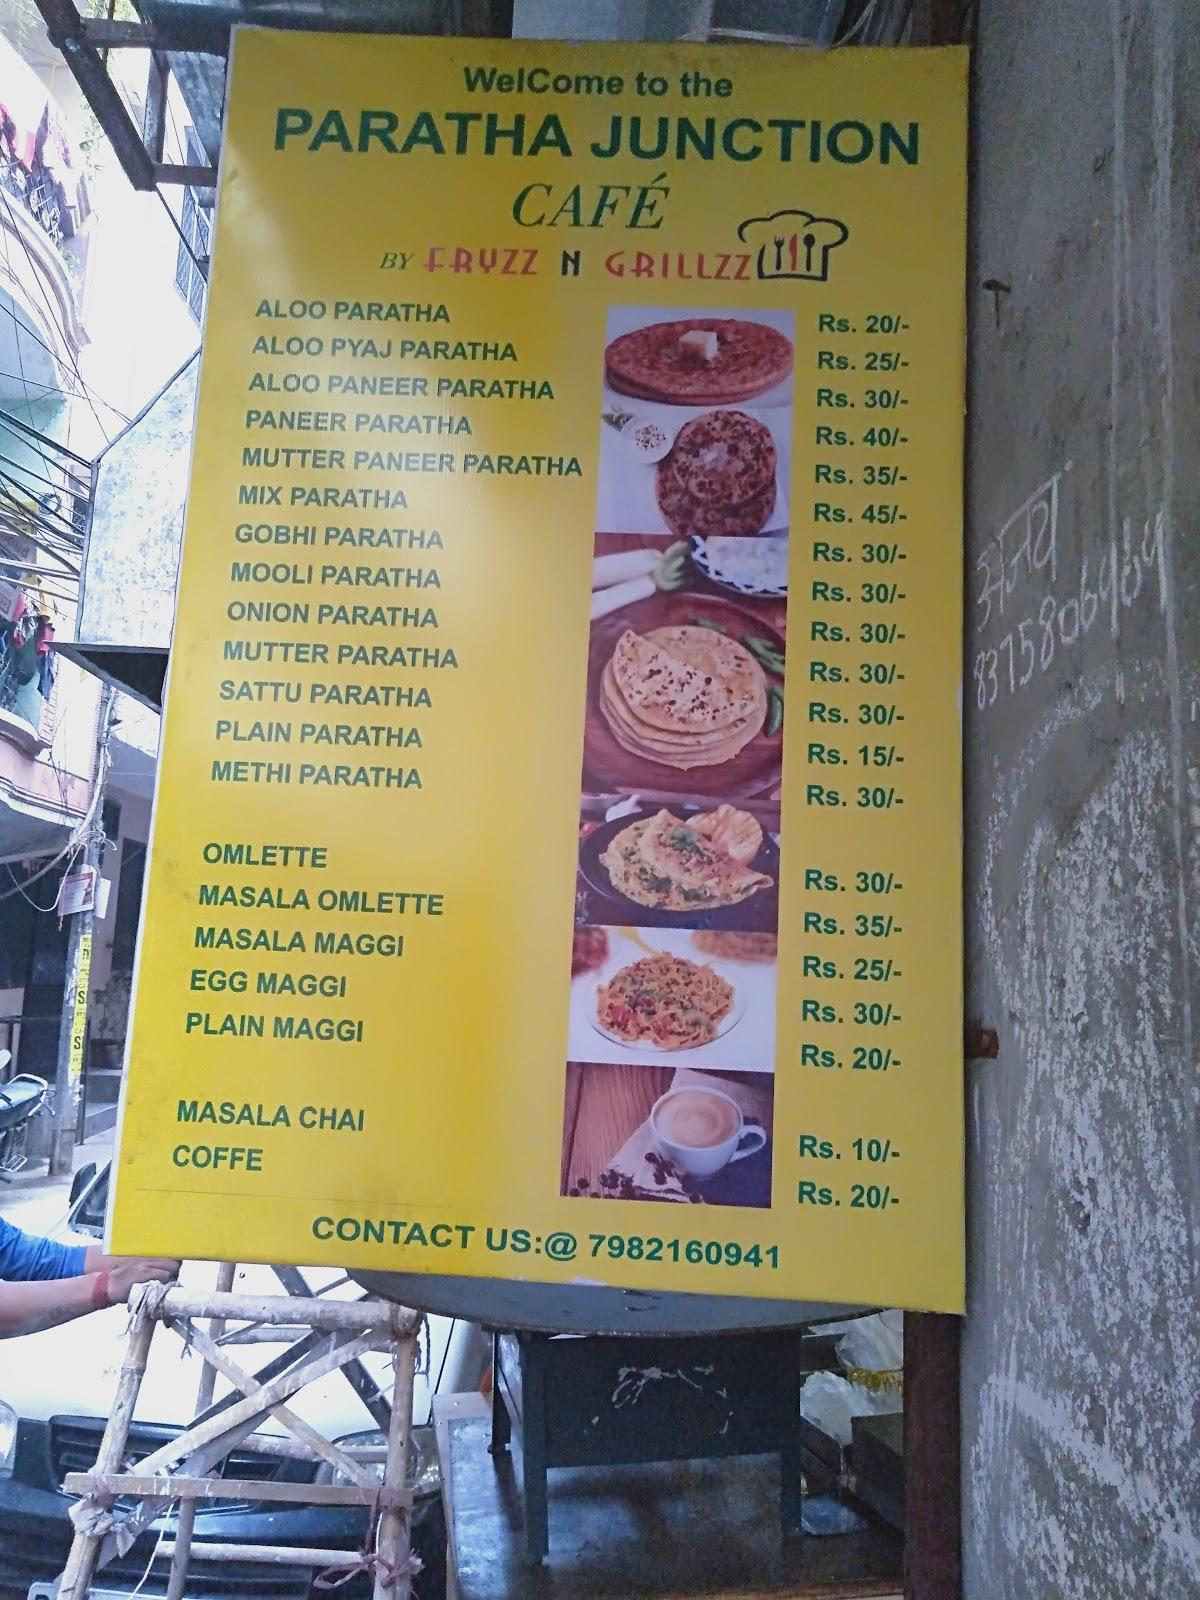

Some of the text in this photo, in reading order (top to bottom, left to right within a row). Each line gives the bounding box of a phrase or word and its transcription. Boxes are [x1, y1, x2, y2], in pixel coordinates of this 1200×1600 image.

[464, 66, 733, 98] WelCome to the
[274, 108, 919, 165] PARATHA JUNCTION
[512, 172, 670, 229] CAFÉ
[380, 248, 752, 281] BY FRYZZ N GRILLZZ
[255, 299, 450, 323] ALOO PARATHA
[819, 312, 909, 334] Rs. 20/-
[252, 336, 518, 362] ALOO PYAJ PARATHA
[817, 351, 909, 371] Rs. 25/-
[248, 373, 554, 400] ALOO PANEER PARATHA
[817, 388, 908, 409] Rs. 30/-
[246, 410, 472, 435] PANEER PARATHA
[816, 426, 908, 447] Rs. 40/-
[243, 447, 582, 476] MUTTER PANEER PARATHA
[815, 464, 908, 486] Rs. 35/-
[239, 485, 407, 509] MIX PARATHA
[813, 503, 907, 524] Rs. 45/-
[235, 524, 443, 549] GOBHI PARATHA
[813, 542, 907, 564] Rs. 30/-
[231, 562, 441, 588] MOOLI PARATHA
[812, 581, 906, 604] Rs. 30/-
[227, 601, 438, 628] ONION PARATHA
[811, 621, 906, 644] Rs. 30/-
[224, 640, 458, 668] MUTTER PARATHA
[810, 661, 905, 684] Rs. 30/-
[219, 680, 432, 708] SATTU PARATHA
[809, 702, 904, 726] Rs. 30/-
[216, 720, 422, 748] PLAIN PARATHA
[808, 743, 904, 767] Rs. 15/-
[212, 761, 422, 789] METHI PARATHA
[807, 784, 904, 808] Rs. 30/-
[203, 843, 327, 868] OMLETTE
[805, 869, 903, 894] Rs. 30/-
[198, 884, 444, 916] MASALA OMLETTE
[804, 912, 902, 938] Rs. 35/-
[195, 926, 404, 957] MASALA MAGGI
[803, 955, 902, 982] Rs. 25/-
[190, 968, 346, 997] EGG MAGGI
[802, 999, 901, 1026] Rs. 30/-
[185, 1012, 363, 1042] PLAIN MAGGI
[800, 1044, 901, 1071] Rs. 20/-
[177, 1100, 364, 1131] MASALA CHAI
[172, 1144, 263, 1171] COFFE
[799, 1135, 900, 1163] Rs. 10/-
[798, 1180, 899, 1210] Rs. 20/-
[312, 1216, 475, 1249] CONTACT
[589, 1234, 778, 1269] 7982160941
